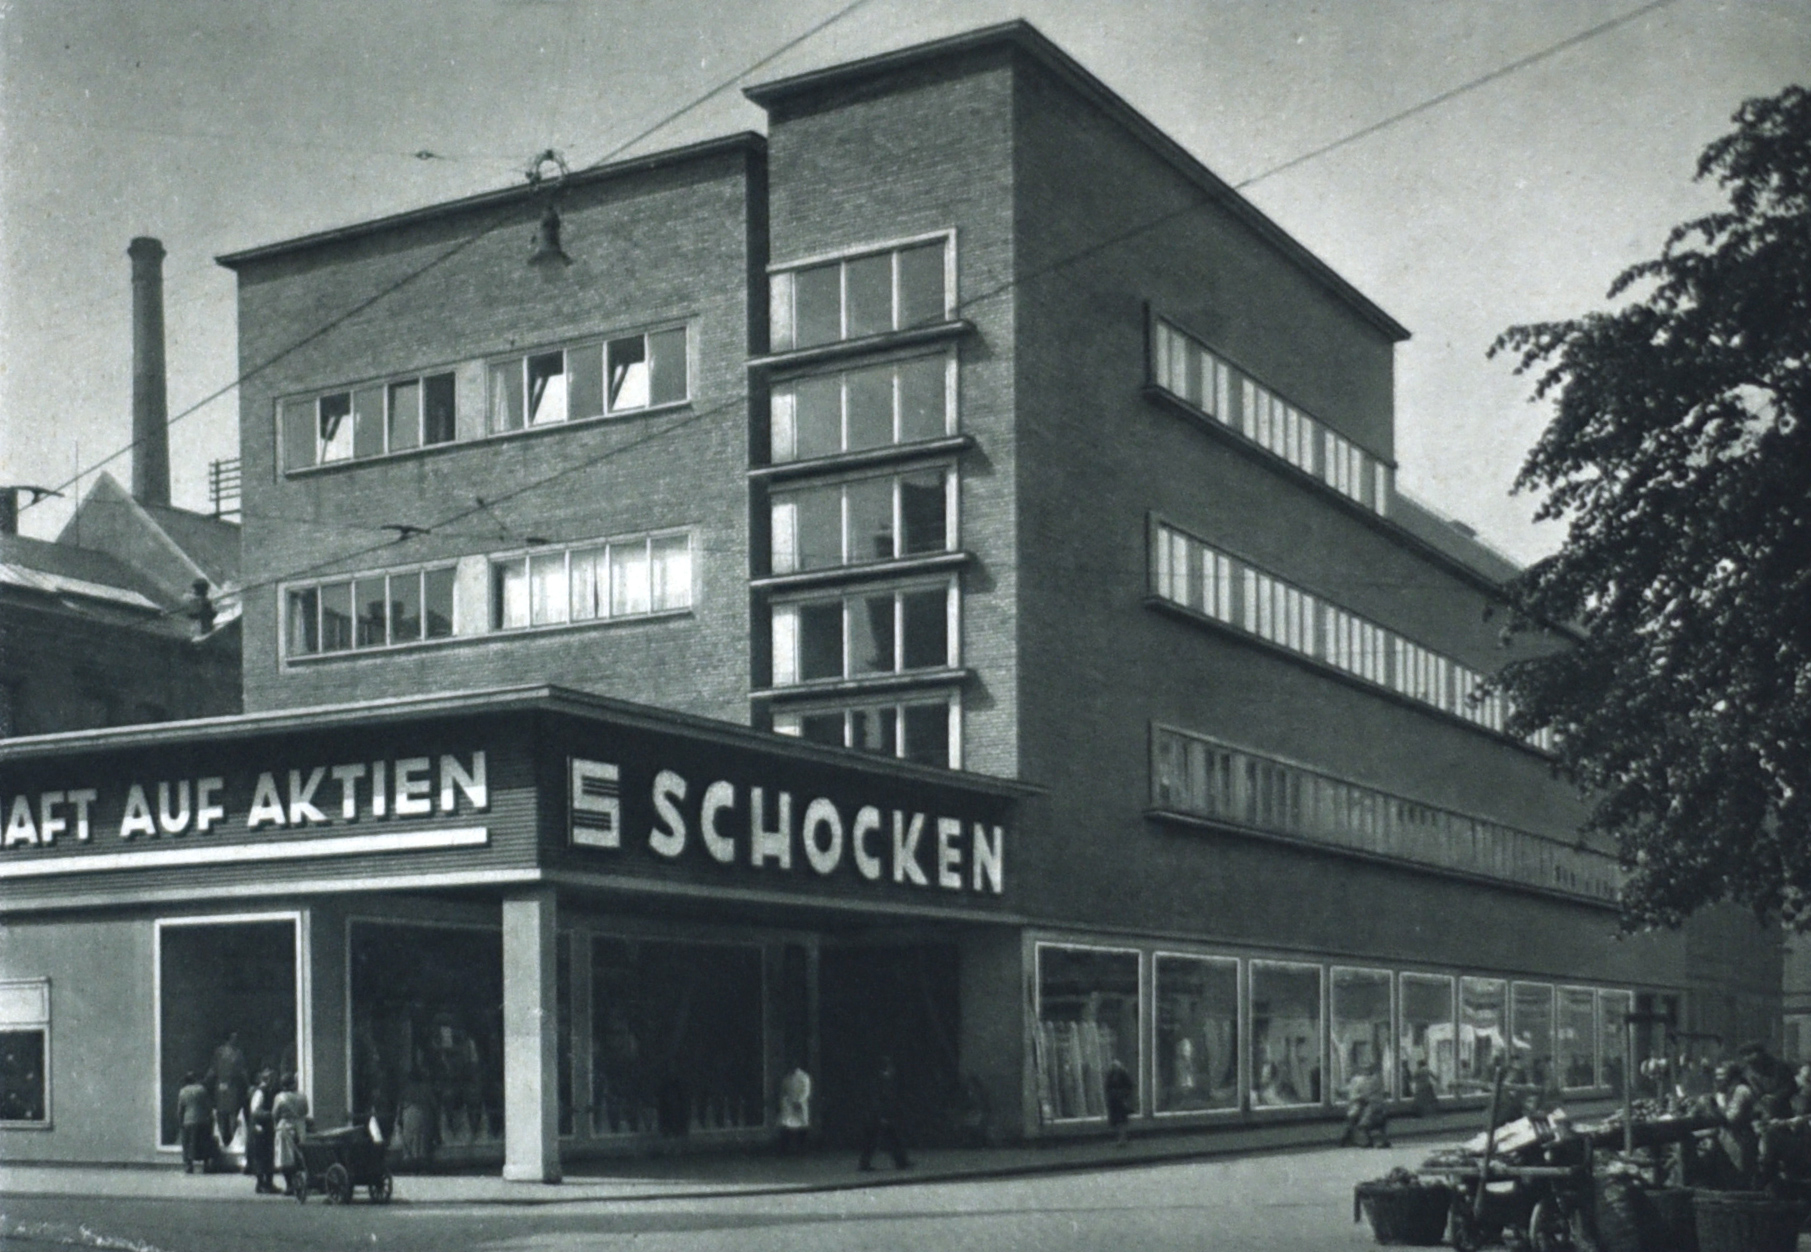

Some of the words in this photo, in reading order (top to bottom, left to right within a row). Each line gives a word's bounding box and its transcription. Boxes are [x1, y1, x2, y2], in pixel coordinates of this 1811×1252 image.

[0, 788, 97, 847] AFT
[119, 776, 225, 837] AUF
[247, 750, 488, 828] AKTIEN
[648, 769, 1005, 894] SCHOCKEN
